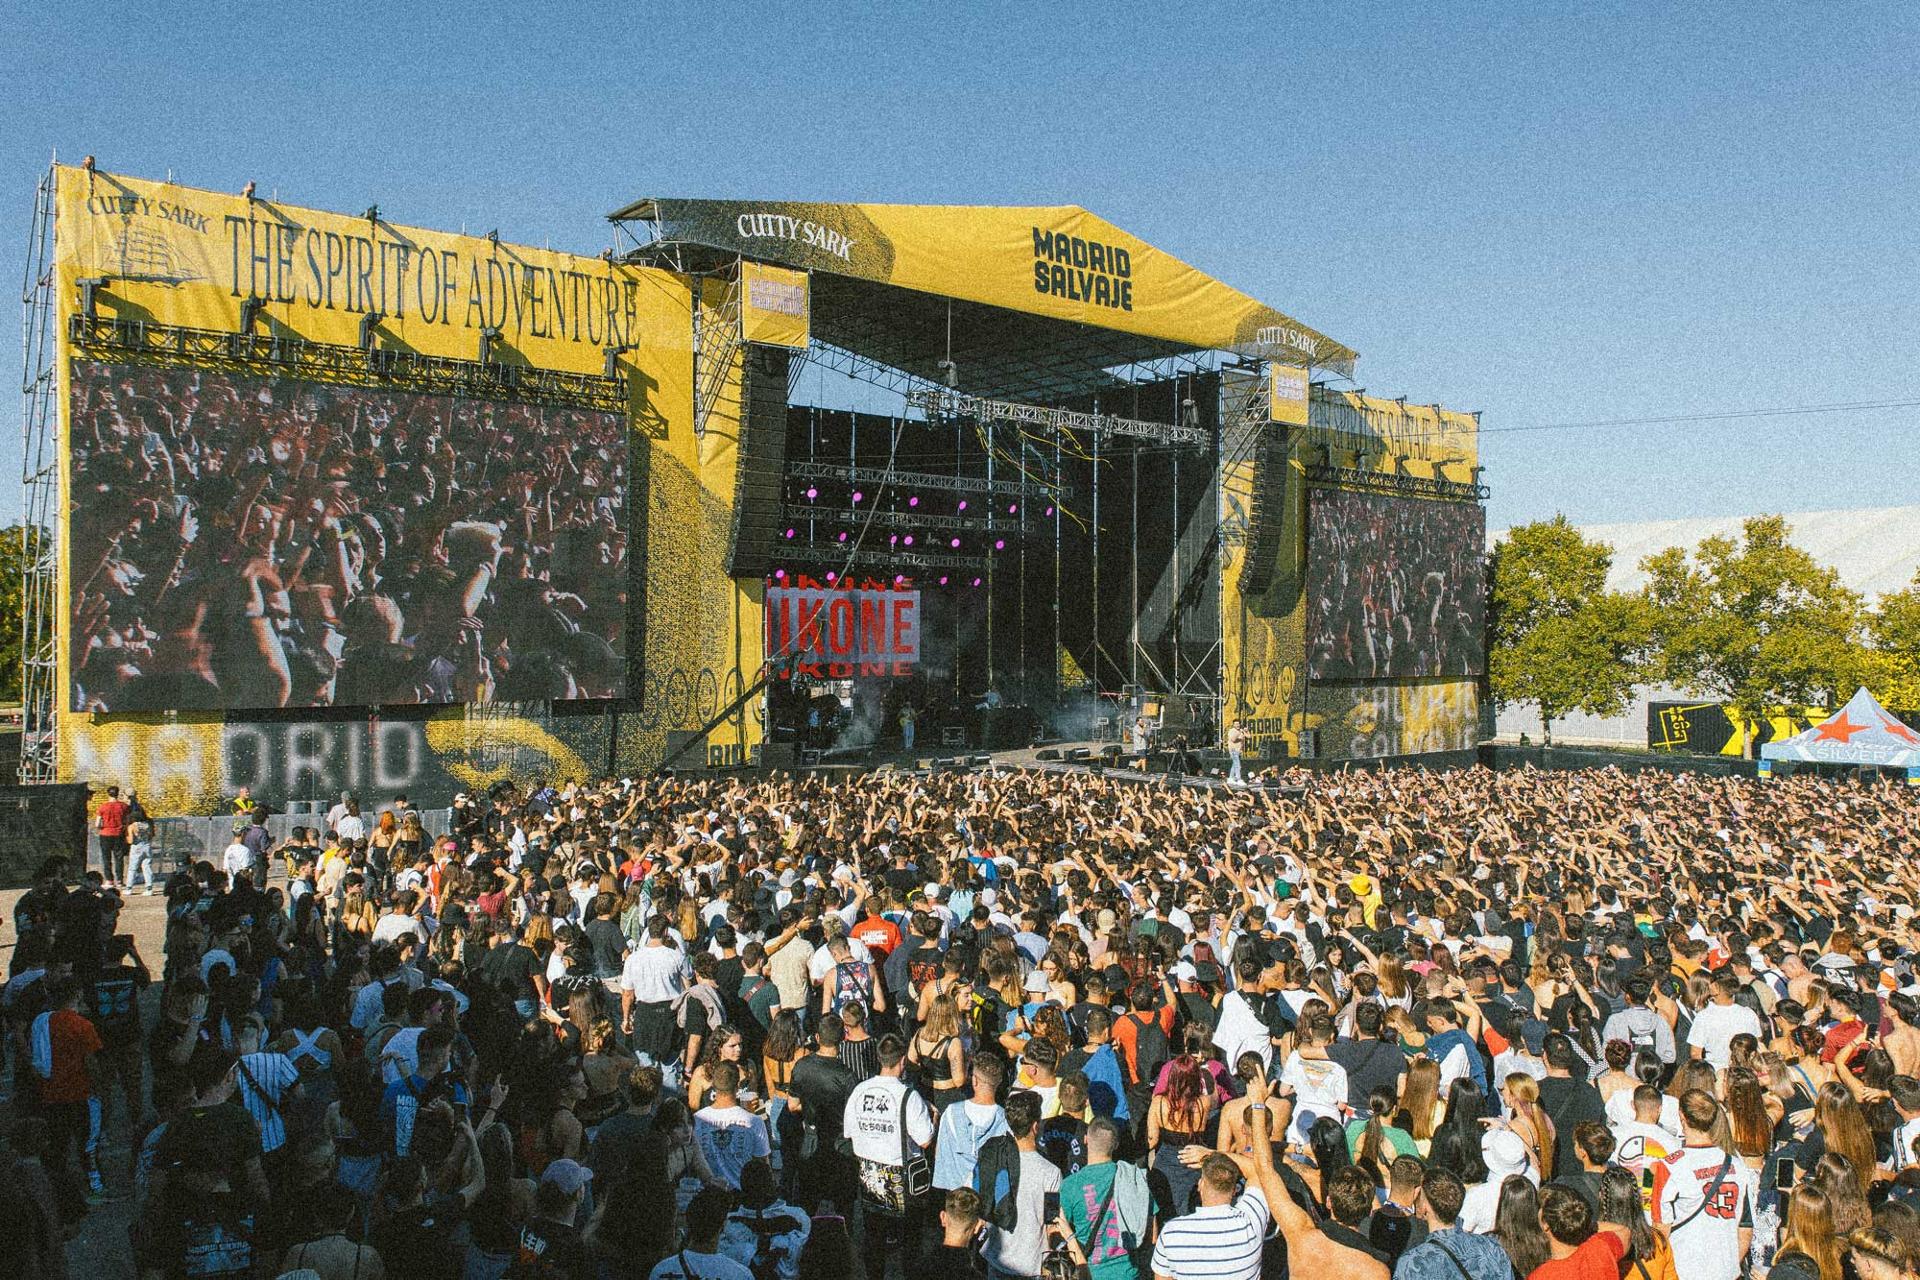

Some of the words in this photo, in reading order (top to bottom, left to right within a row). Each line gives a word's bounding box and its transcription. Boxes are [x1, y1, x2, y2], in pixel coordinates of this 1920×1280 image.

[87, 195, 155, 217] CUTTY
[156, 200, 212, 234] SARK
[737, 213, 801, 241] CUTTY
[801, 220, 856, 263] SARK
[1032, 226, 1132, 279] MADRID
[224, 214, 296, 304] THE
[306, 227, 409, 320] SPIRIT
[417, 246, 459, 325] OF
[464, 255, 641, 350] ADVENTURE
[1034, 260, 1133, 312] SALVAJE
[1256, 326, 1288, 346] CUTTY
[1289, 329, 1319, 358] SARK
[767, 597, 914, 657] IKONE
[1247, 717, 1282, 734] ADRID
[75, 721, 421, 798] MADRID
[1816, 748, 1887, 762] SILVER
